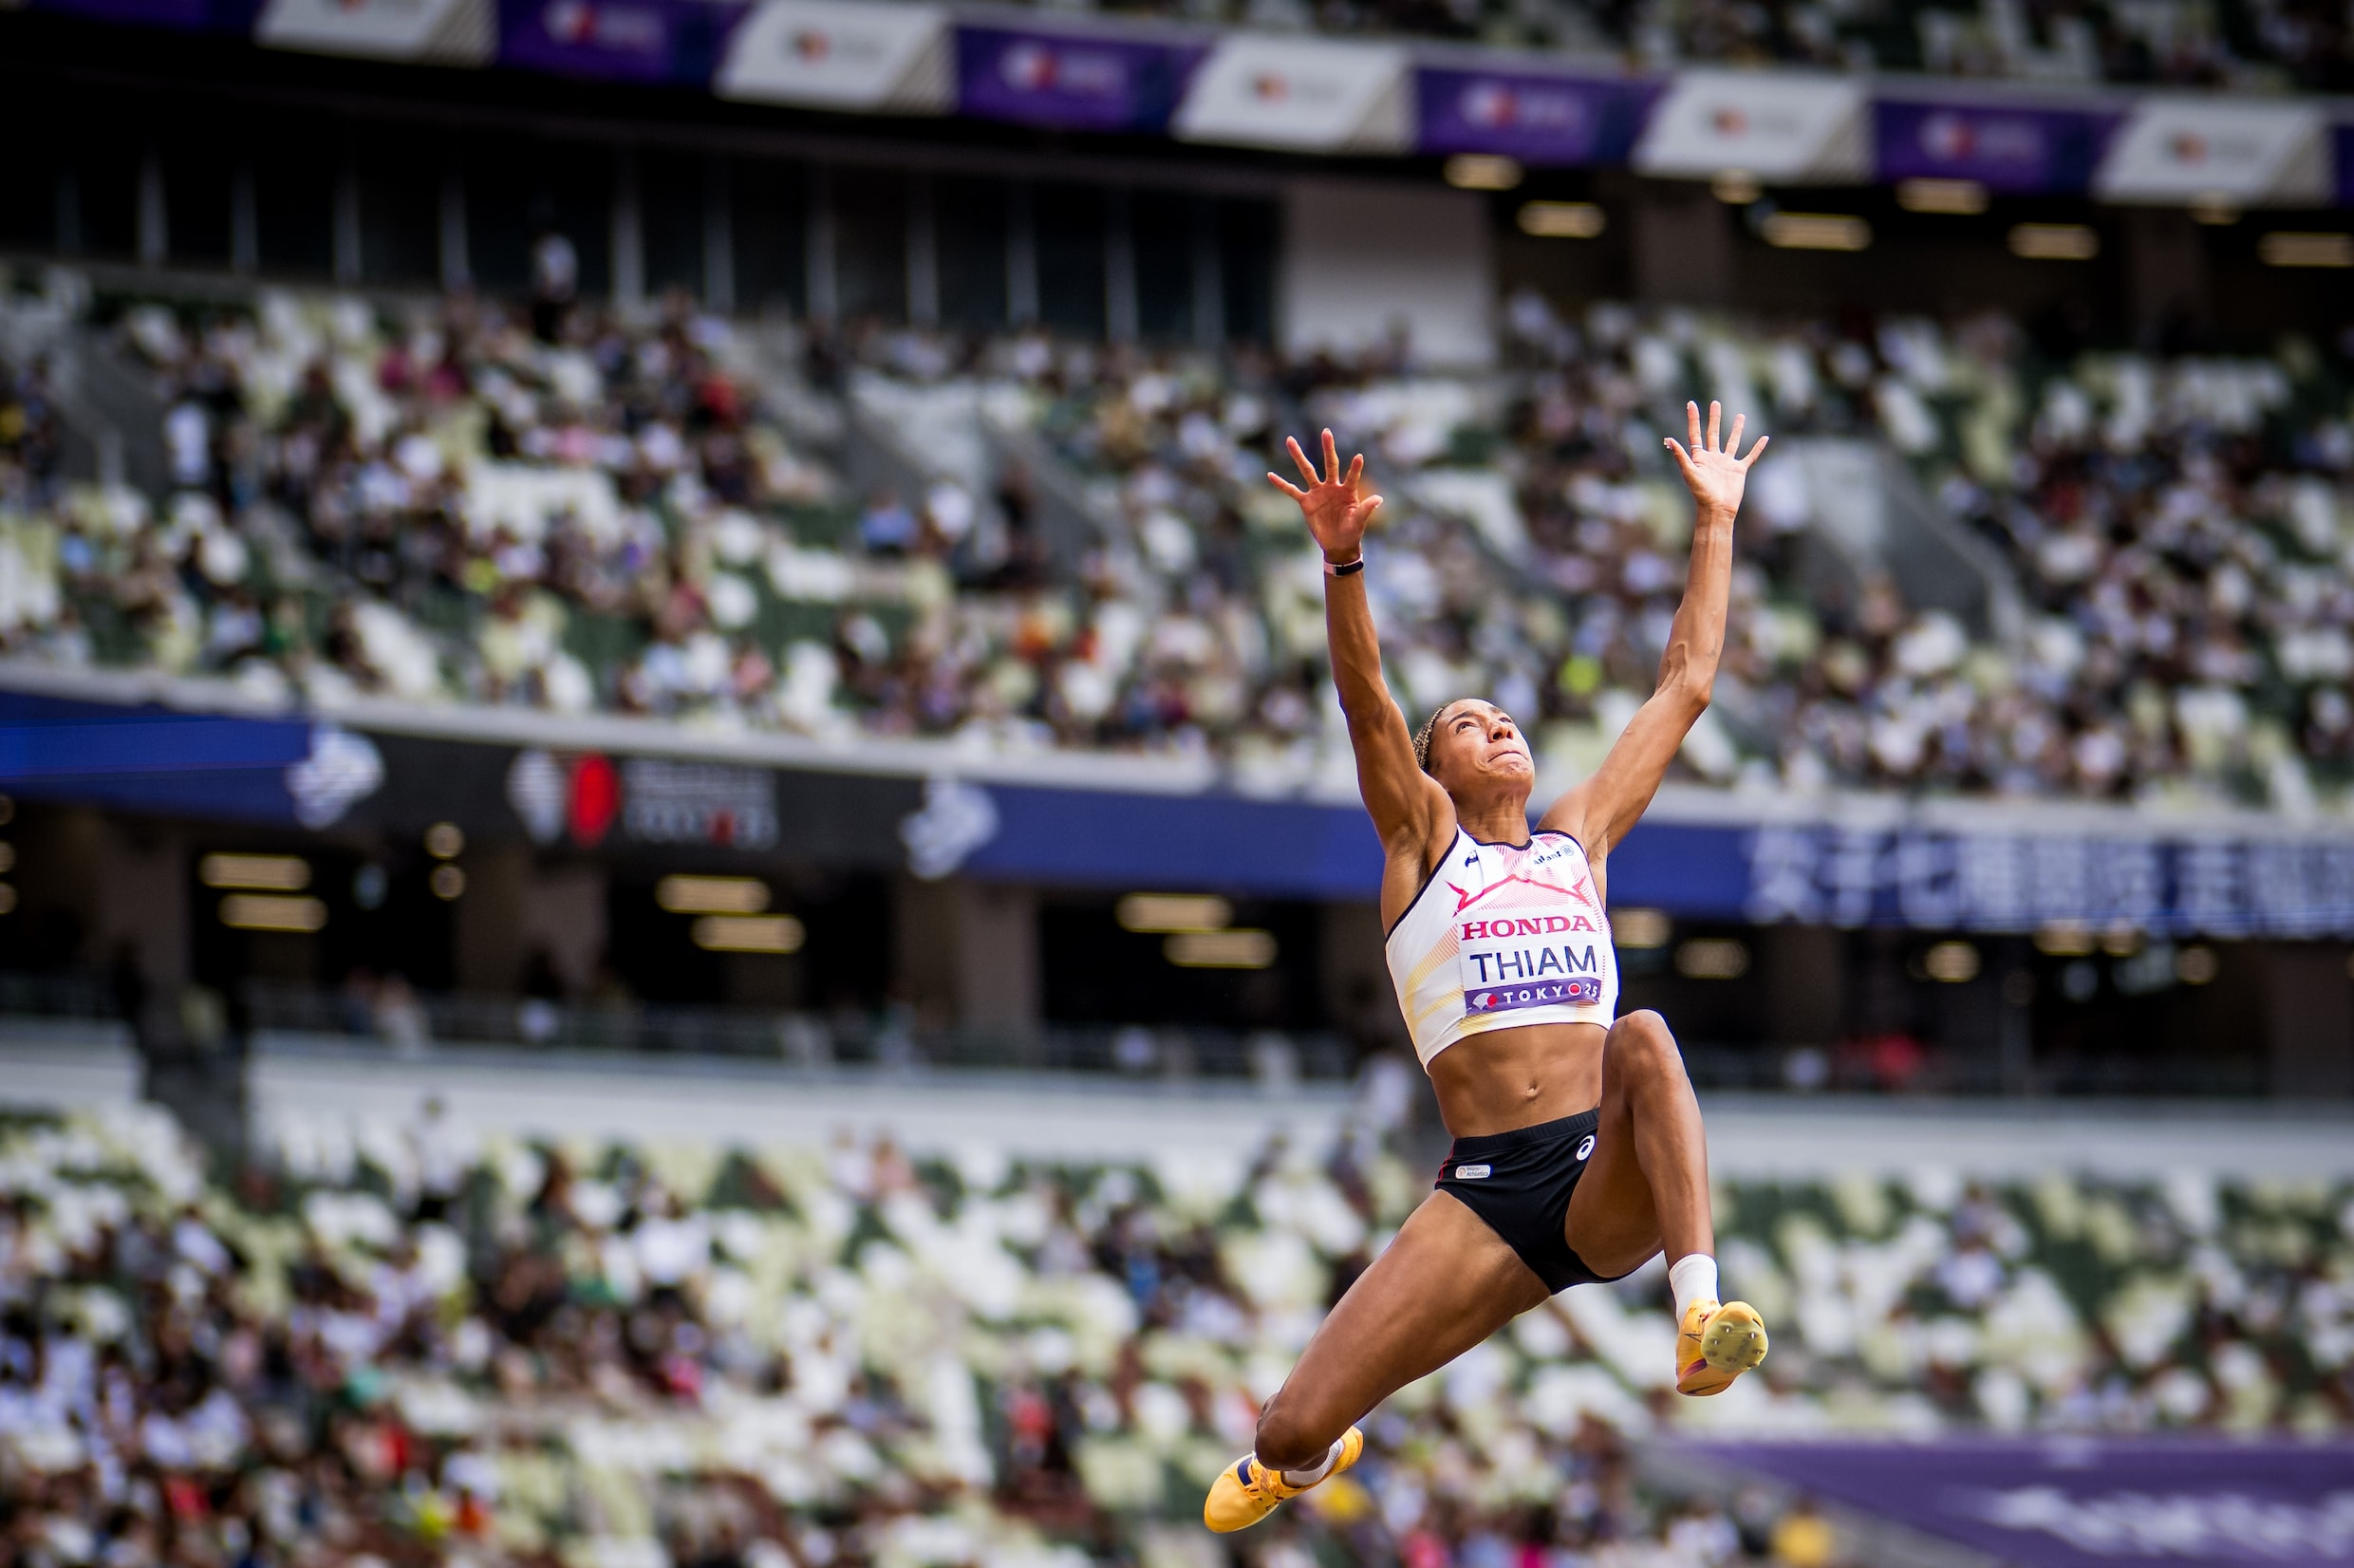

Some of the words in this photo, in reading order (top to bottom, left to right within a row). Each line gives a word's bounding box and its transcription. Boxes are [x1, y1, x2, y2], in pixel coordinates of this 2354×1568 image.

[1533, 850, 1562, 866] Allanz
[1461, 915, 1597, 941] HONDA
[1469, 945, 1597, 982] THIAM
[1585, 982, 1598, 998] 25
